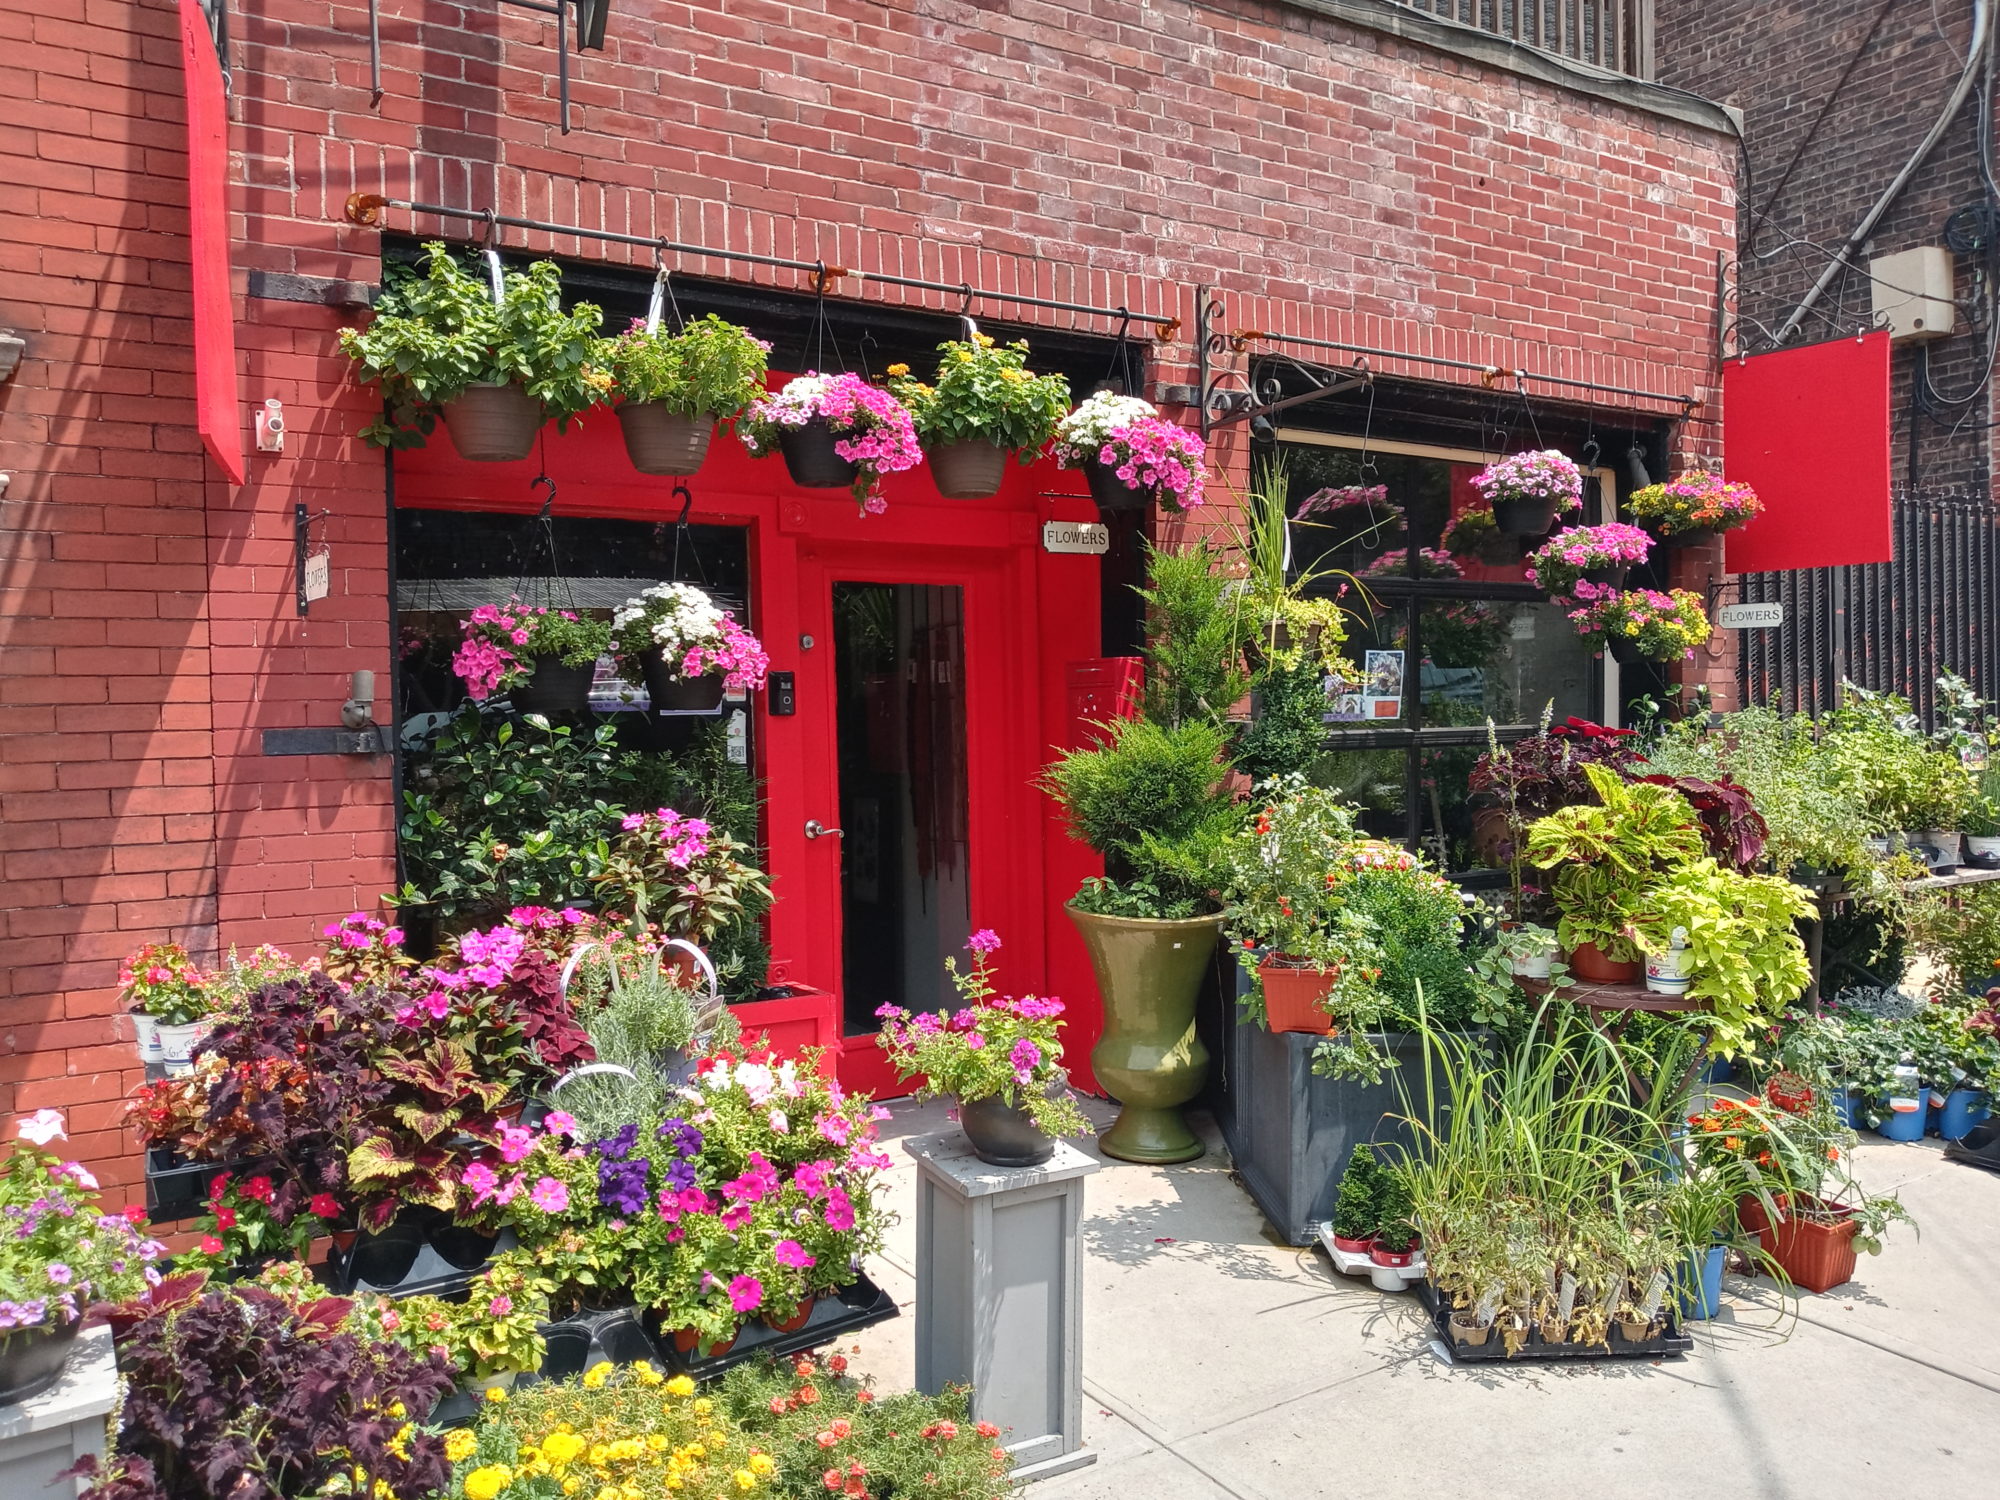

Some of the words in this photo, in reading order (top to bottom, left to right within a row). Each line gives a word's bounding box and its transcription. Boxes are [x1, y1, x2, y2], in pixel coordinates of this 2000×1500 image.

[1047, 530, 1106, 545] FLOWERS
[306, 567, 327, 589] FLOWERS
[1722, 609, 1780, 622] FLOWERS
